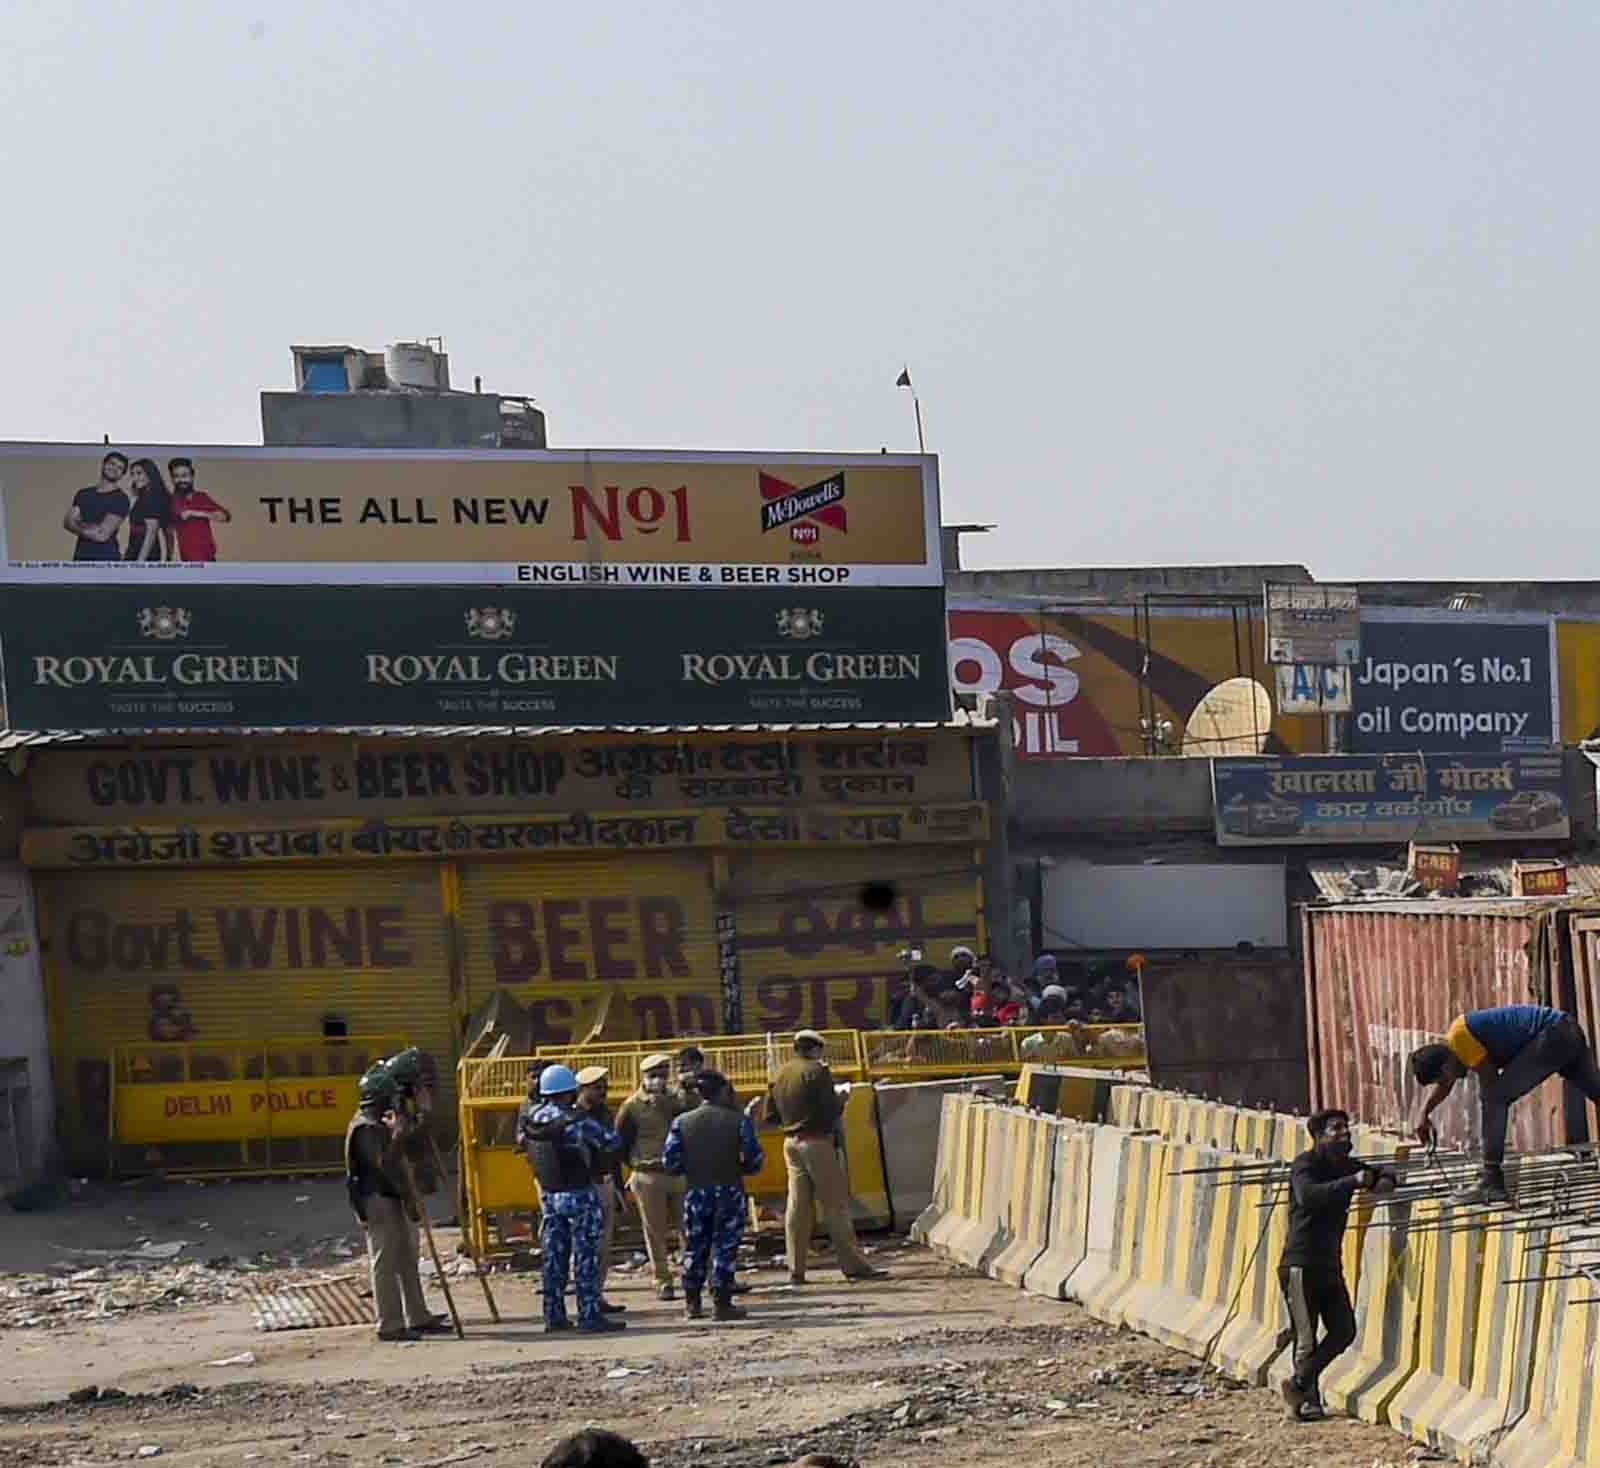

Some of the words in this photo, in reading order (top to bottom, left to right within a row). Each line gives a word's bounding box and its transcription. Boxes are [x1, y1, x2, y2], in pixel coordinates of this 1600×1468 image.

[260, 497, 342, 524] THE
[360, 497, 438, 524] ALL
[454, 498, 549, 525] NEW
[517, 565, 619, 582] ENGLISH
[627, 566, 691, 582] WINE
[698, 567, 713, 582] &
[720, 566, 780, 583] BEER
[787, 567, 850, 584] SHOP
[32, 655, 167, 688] ROYAL
[172, 654, 300, 683] GREEN
[366, 654, 491, 687] ROYAL
[498, 653, 621, 682] GREEN
[681, 653, 803, 686] ROYAL
[806, 653, 920, 681] GREEN
[1482, 657, 1532, 686] No.1
[1011, 711, 1080, 753] IL
[1357, 708, 1393, 734] oil
[1400, 706, 1530, 739] Company
[210, 755, 326, 803] WINE
[331, 762, 351, 793] &
[354, 751, 457, 800] BEER
[463, 749, 564, 798] SHOP
[209, 829, 319, 859] शराब
[214, 906, 413, 969] WINE
[487, 898, 690, 984] BEER
[147, 984, 198, 1042] &
[164, 1095, 232, 1119] DELHI
[250, 1088, 338, 1114] POLICE
